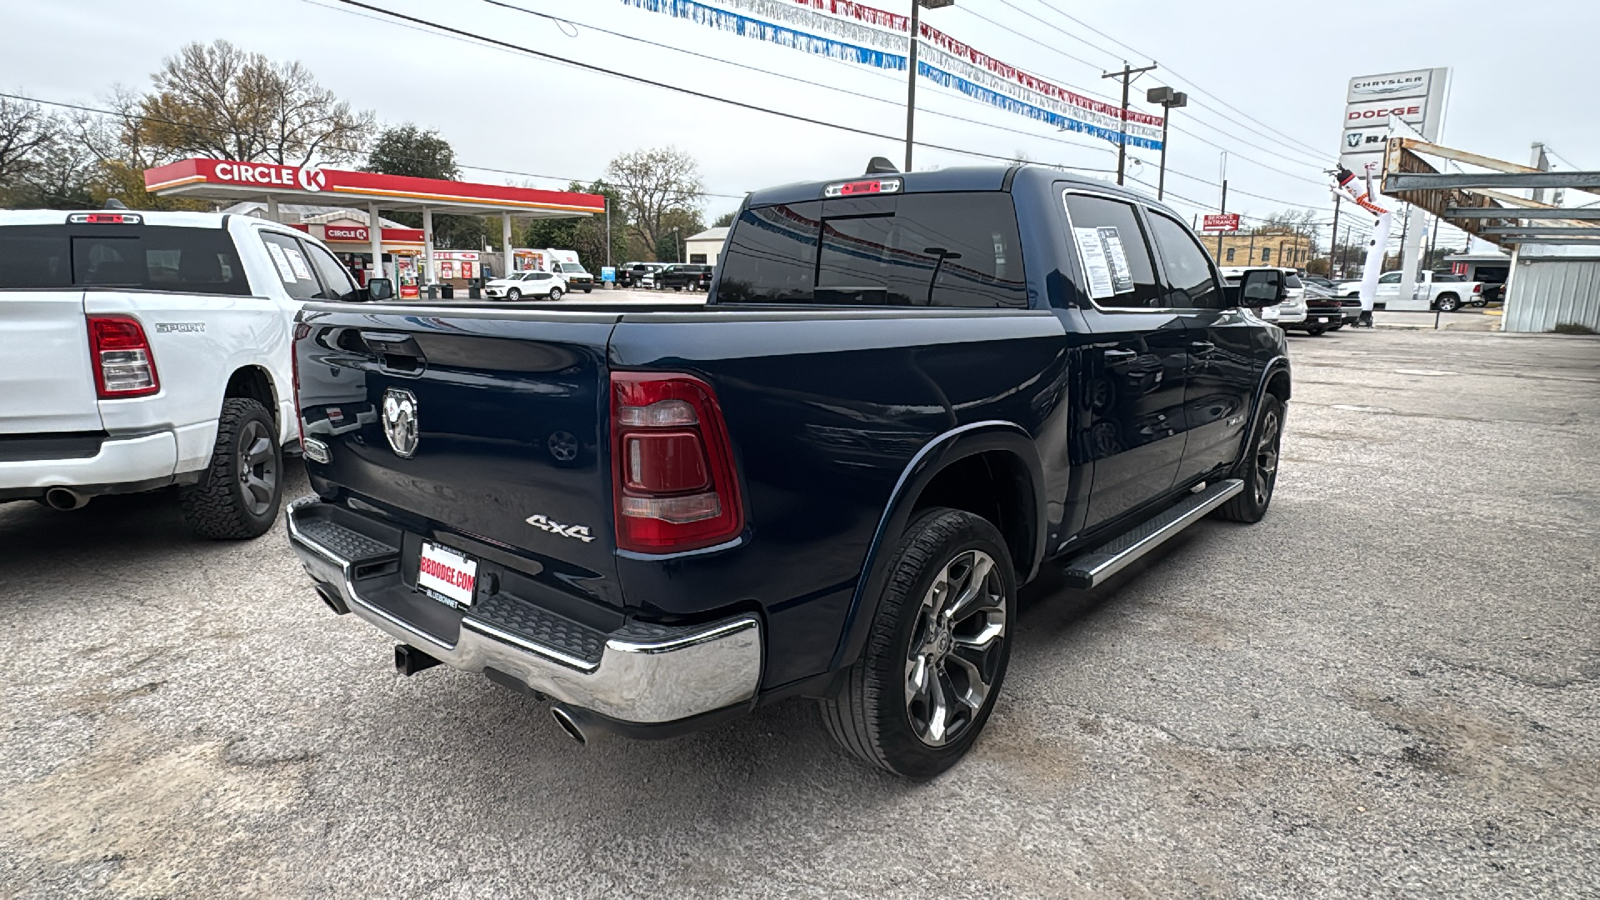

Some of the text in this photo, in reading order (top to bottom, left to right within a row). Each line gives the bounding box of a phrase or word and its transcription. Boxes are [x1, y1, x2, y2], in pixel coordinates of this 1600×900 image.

[1354, 76, 1422, 89] CHRYSLER
[1348, 106, 1420, 120] DODGE
[215, 163, 324, 190] CIRCLE K
[328, 229, 367, 239] CIRCLE K
[155, 322, 205, 333] SPORT
[421, 556, 475, 593] BBDODGE.COM
[426, 589, 459, 609] BLUEBONNET
